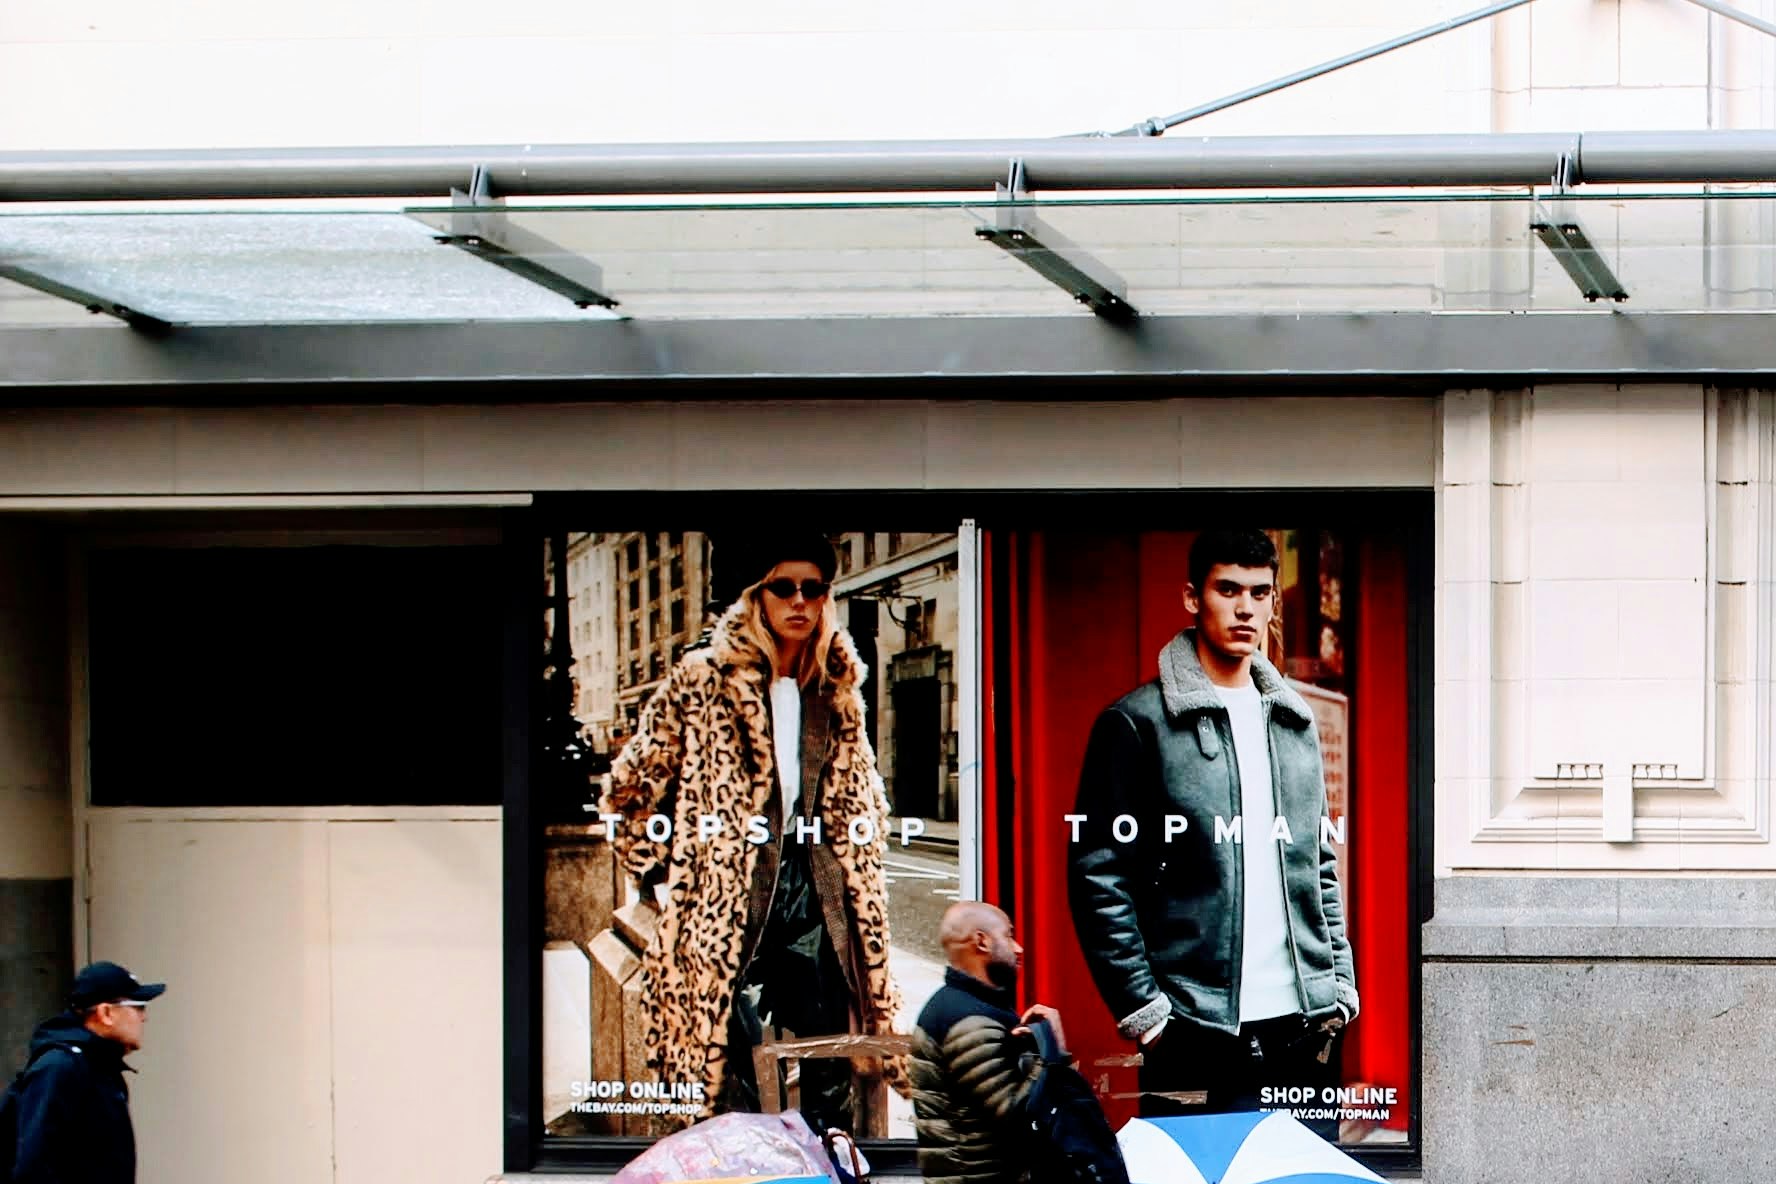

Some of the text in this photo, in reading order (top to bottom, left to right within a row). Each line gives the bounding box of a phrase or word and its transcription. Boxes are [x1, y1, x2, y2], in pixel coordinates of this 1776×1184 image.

[599, 813, 925, 846] TOPSHOP
[1064, 813, 1346, 844] TOPMAN
[570, 1081, 705, 1099] SHOP ONLINE
[1260, 1086, 1398, 1105] SHOP ONLINE
[570, 1102, 702, 1114] THEBAY.COM/TOPSHOP
